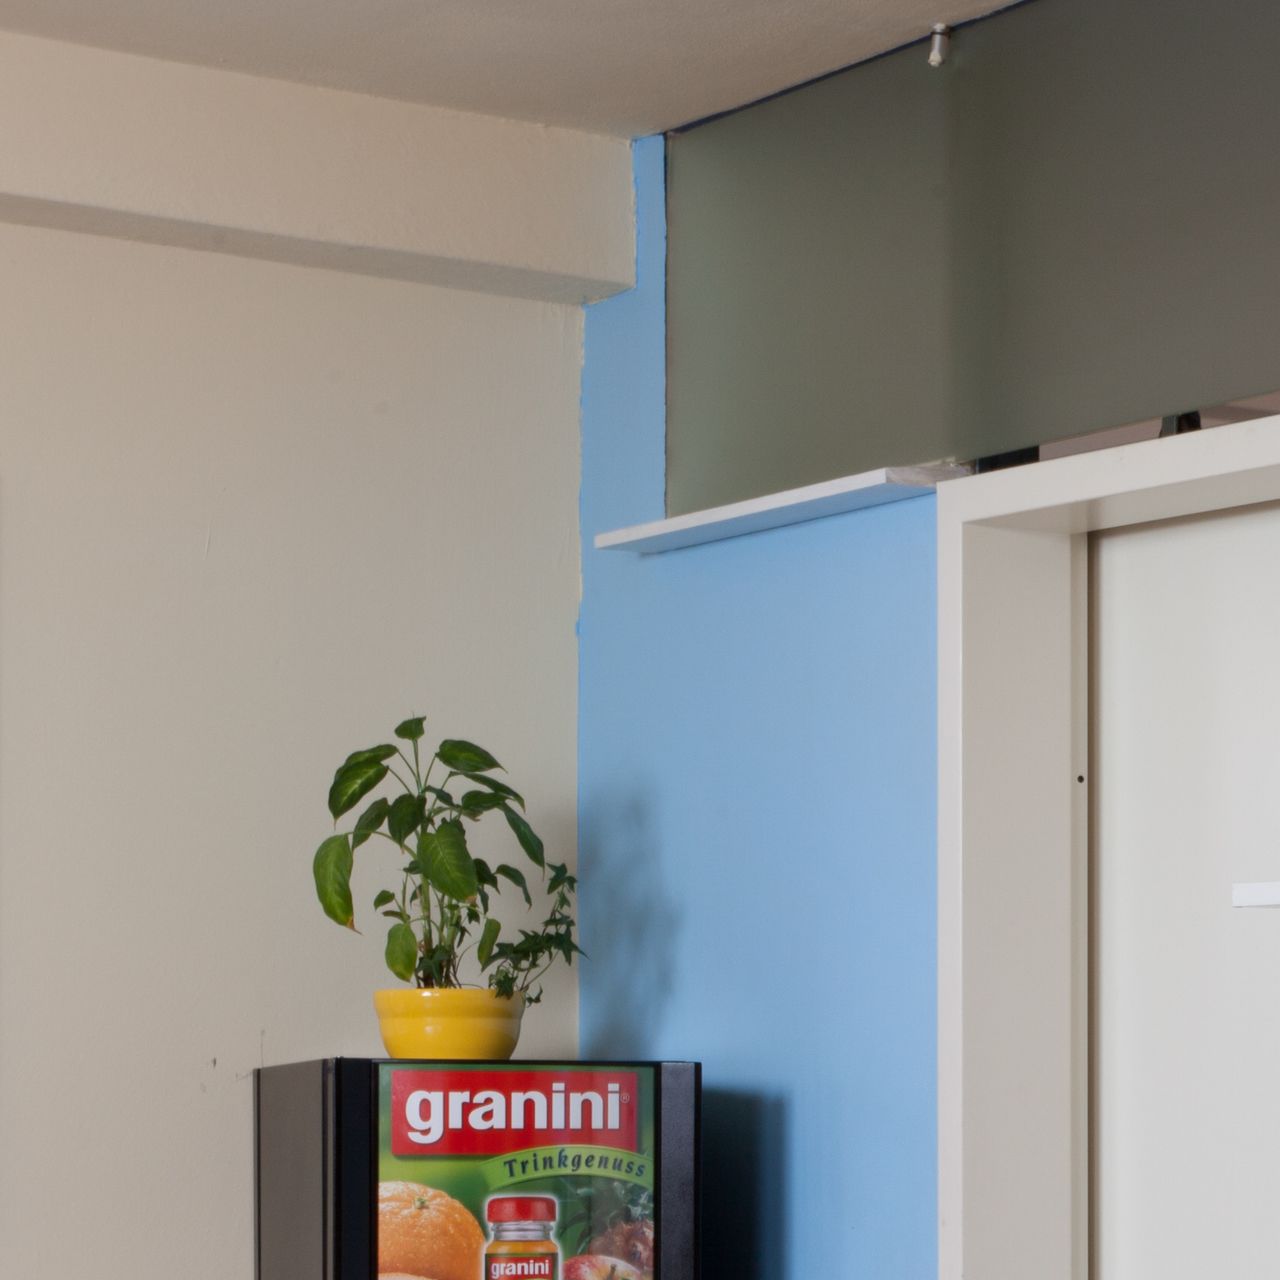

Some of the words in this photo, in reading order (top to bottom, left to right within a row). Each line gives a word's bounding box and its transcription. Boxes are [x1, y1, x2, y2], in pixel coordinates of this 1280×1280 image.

[405, 1082, 620, 1145] granini
[503, 1147, 646, 1179] Trinkgenuss
[491, 1259, 549, 1279] granini
